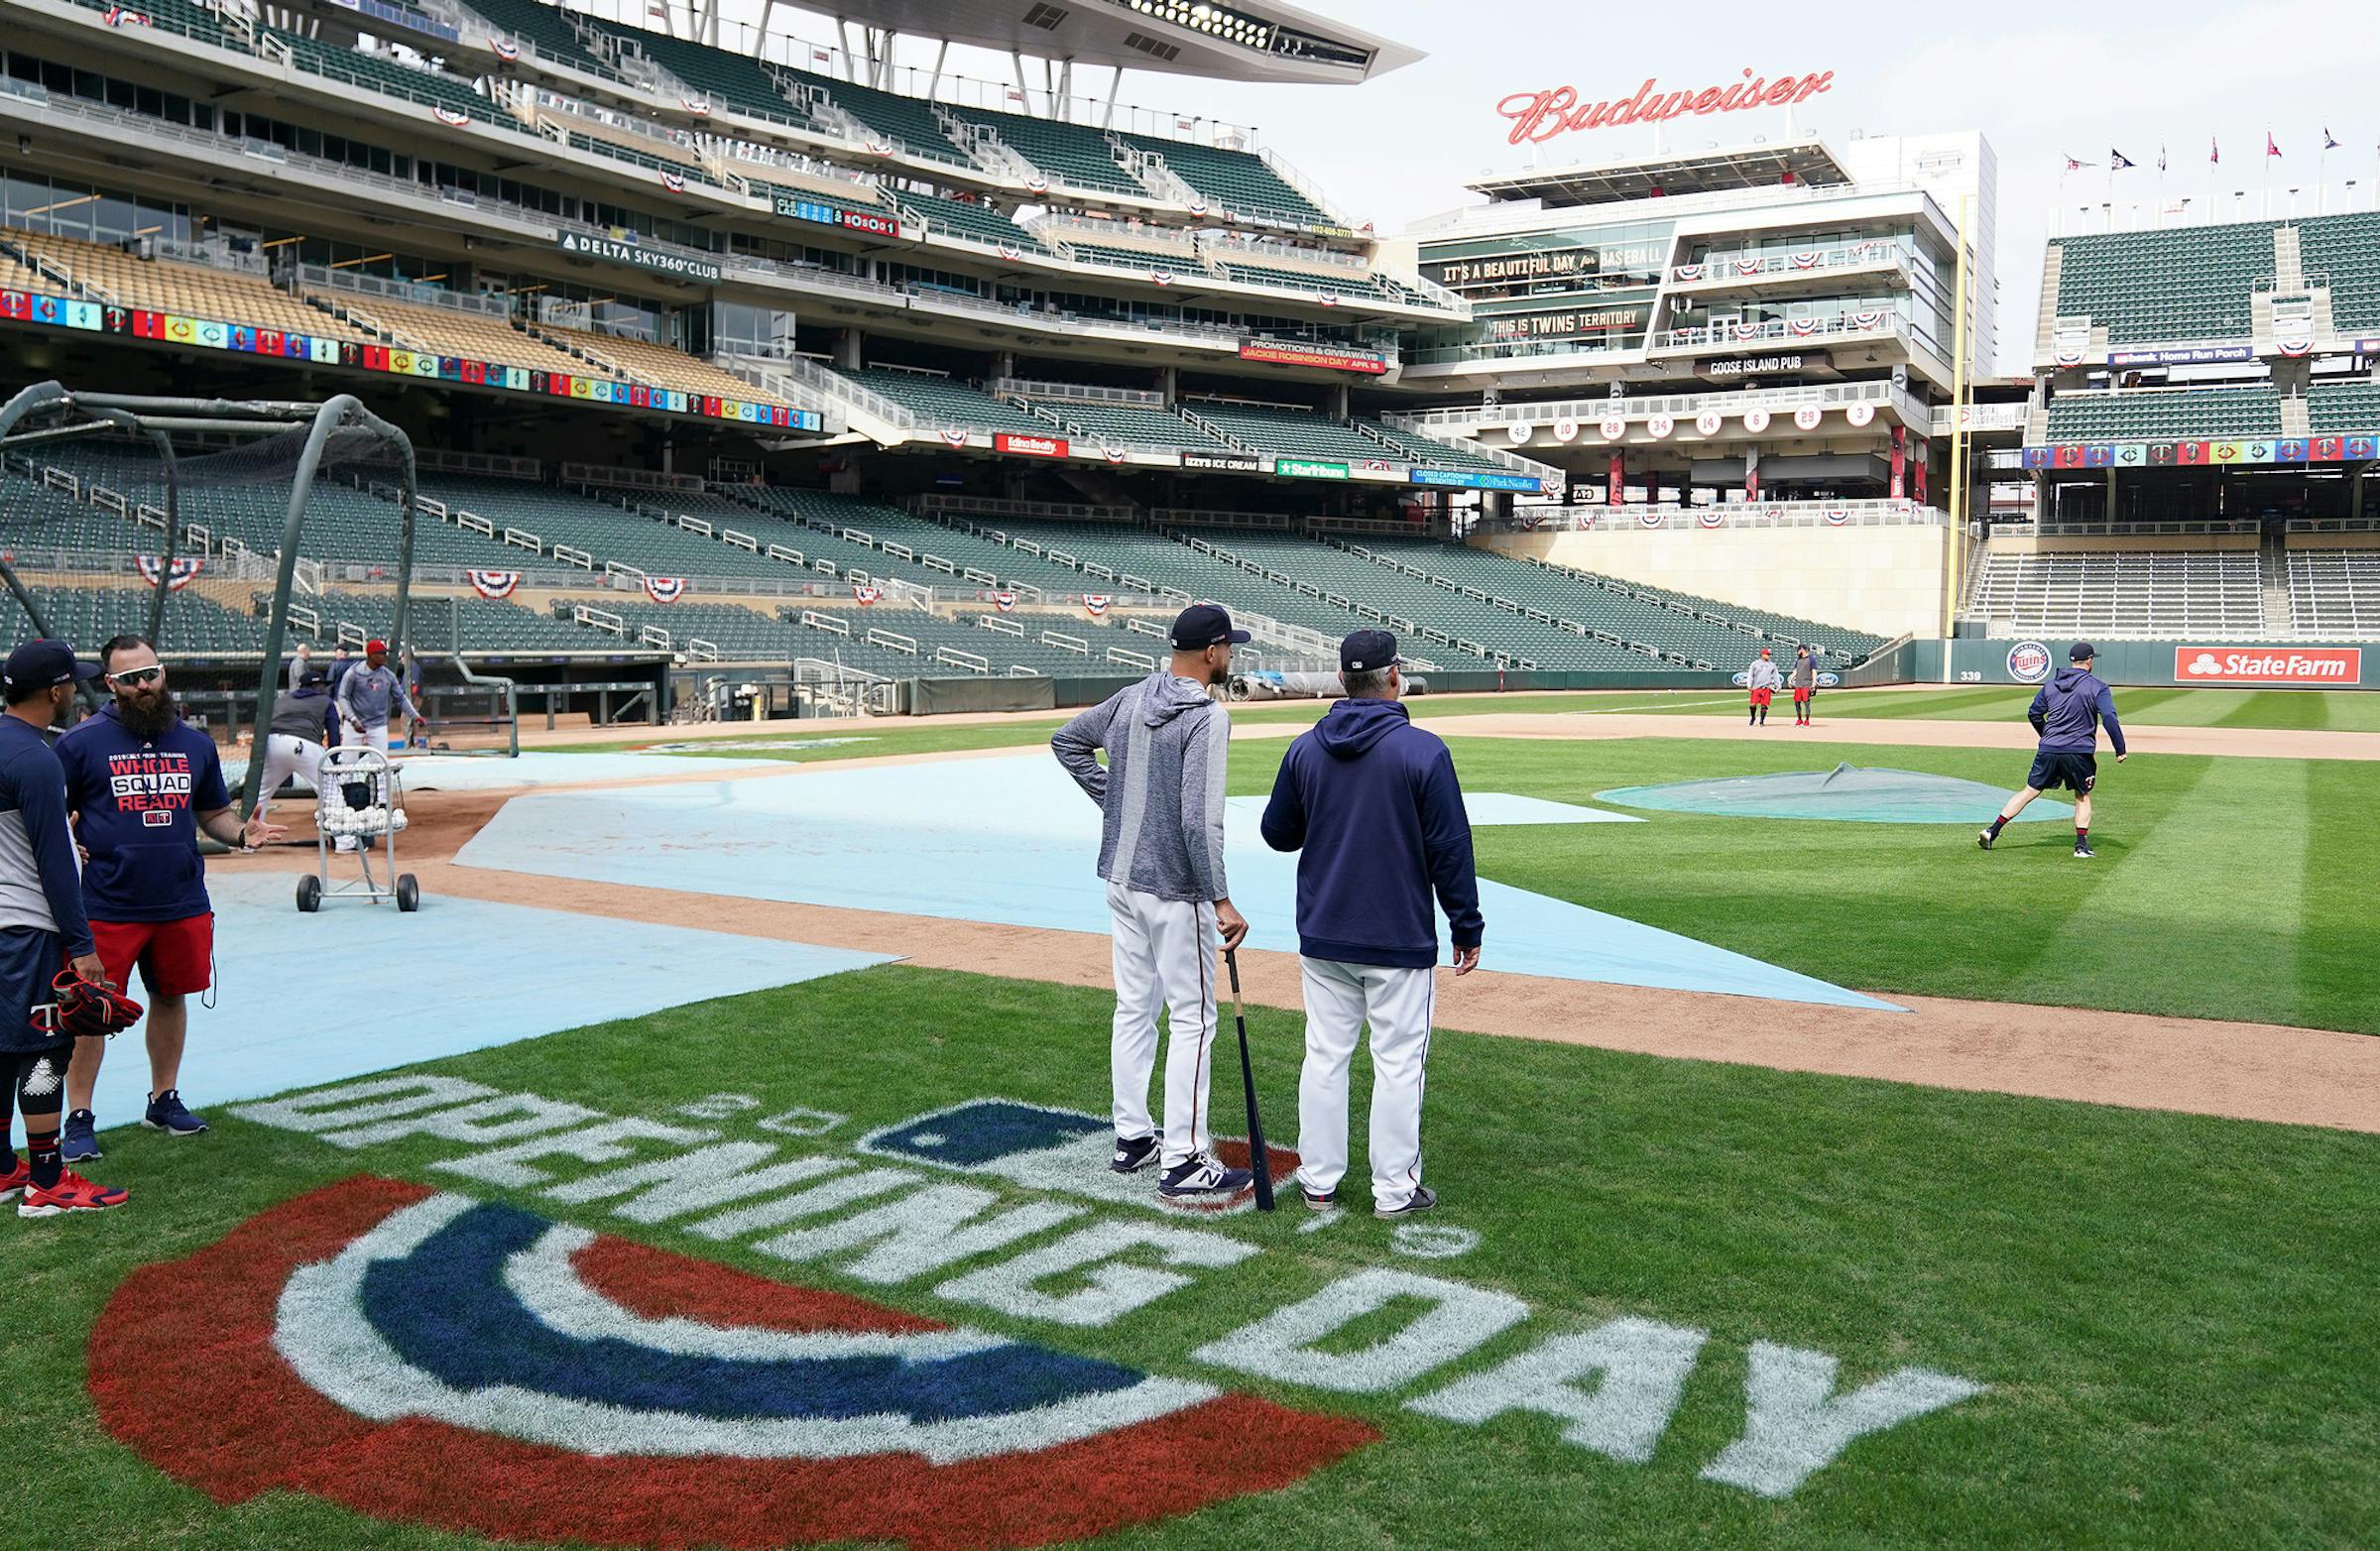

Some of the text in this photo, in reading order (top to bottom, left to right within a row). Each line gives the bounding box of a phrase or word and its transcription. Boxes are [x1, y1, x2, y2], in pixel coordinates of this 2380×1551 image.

[1497, 68, 1835, 145] Budweiser
[777, 198, 796, 209] CLE
[777, 206, 797, 217] LAD
[888, 222, 893, 233] 1
[1254, 215, 1277, 228] Security
[580, 237, 630, 260] DELTA
[1444, 247, 1662, 283] IT'S A BEAUTIFUL DAY for BASEBALL
[1492, 309, 1637, 335] THIS IS TWINS TERRITORY
[1250, 340, 1314, 354] PROMOTIONS
[1324, 347, 1377, 361] GIVEAWAYS
[2160, 351, 2190, 361] Home
[2192, 350, 2212, 360] Run
[2215, 348, 2246, 358] Porch
[1243, 348, 1277, 360] JACKIE
[1278, 352, 1329, 365] ROBINSON
[1329, 357, 1349, 367] DAY
[1711, 355, 1801, 375] GOOSE ISLAND PUB
[1801, 411, 1814, 422] 29
[1856, 408, 1863, 419] 3
[1560, 423, 1571, 435] 10
[1606, 421, 1618, 433] 28
[1654, 420, 1668, 431] 34
[1703, 418, 1714, 428] 14
[1513, 426, 1526, 437] 42
[1212, 459, 1226, 469] ICE
[1227, 459, 1257, 471] CREAM
[1492, 478, 1533, 489] Park Nicollet
[2014, 652, 2046, 671] Twins
[1961, 670, 1981, 682] 339
[109, 759, 190, 775] WHOLE
[114, 776, 189, 792] SQUAD
[117, 793, 190, 811] READY
[228, 1074, 1986, 1498] OPENING DAY
